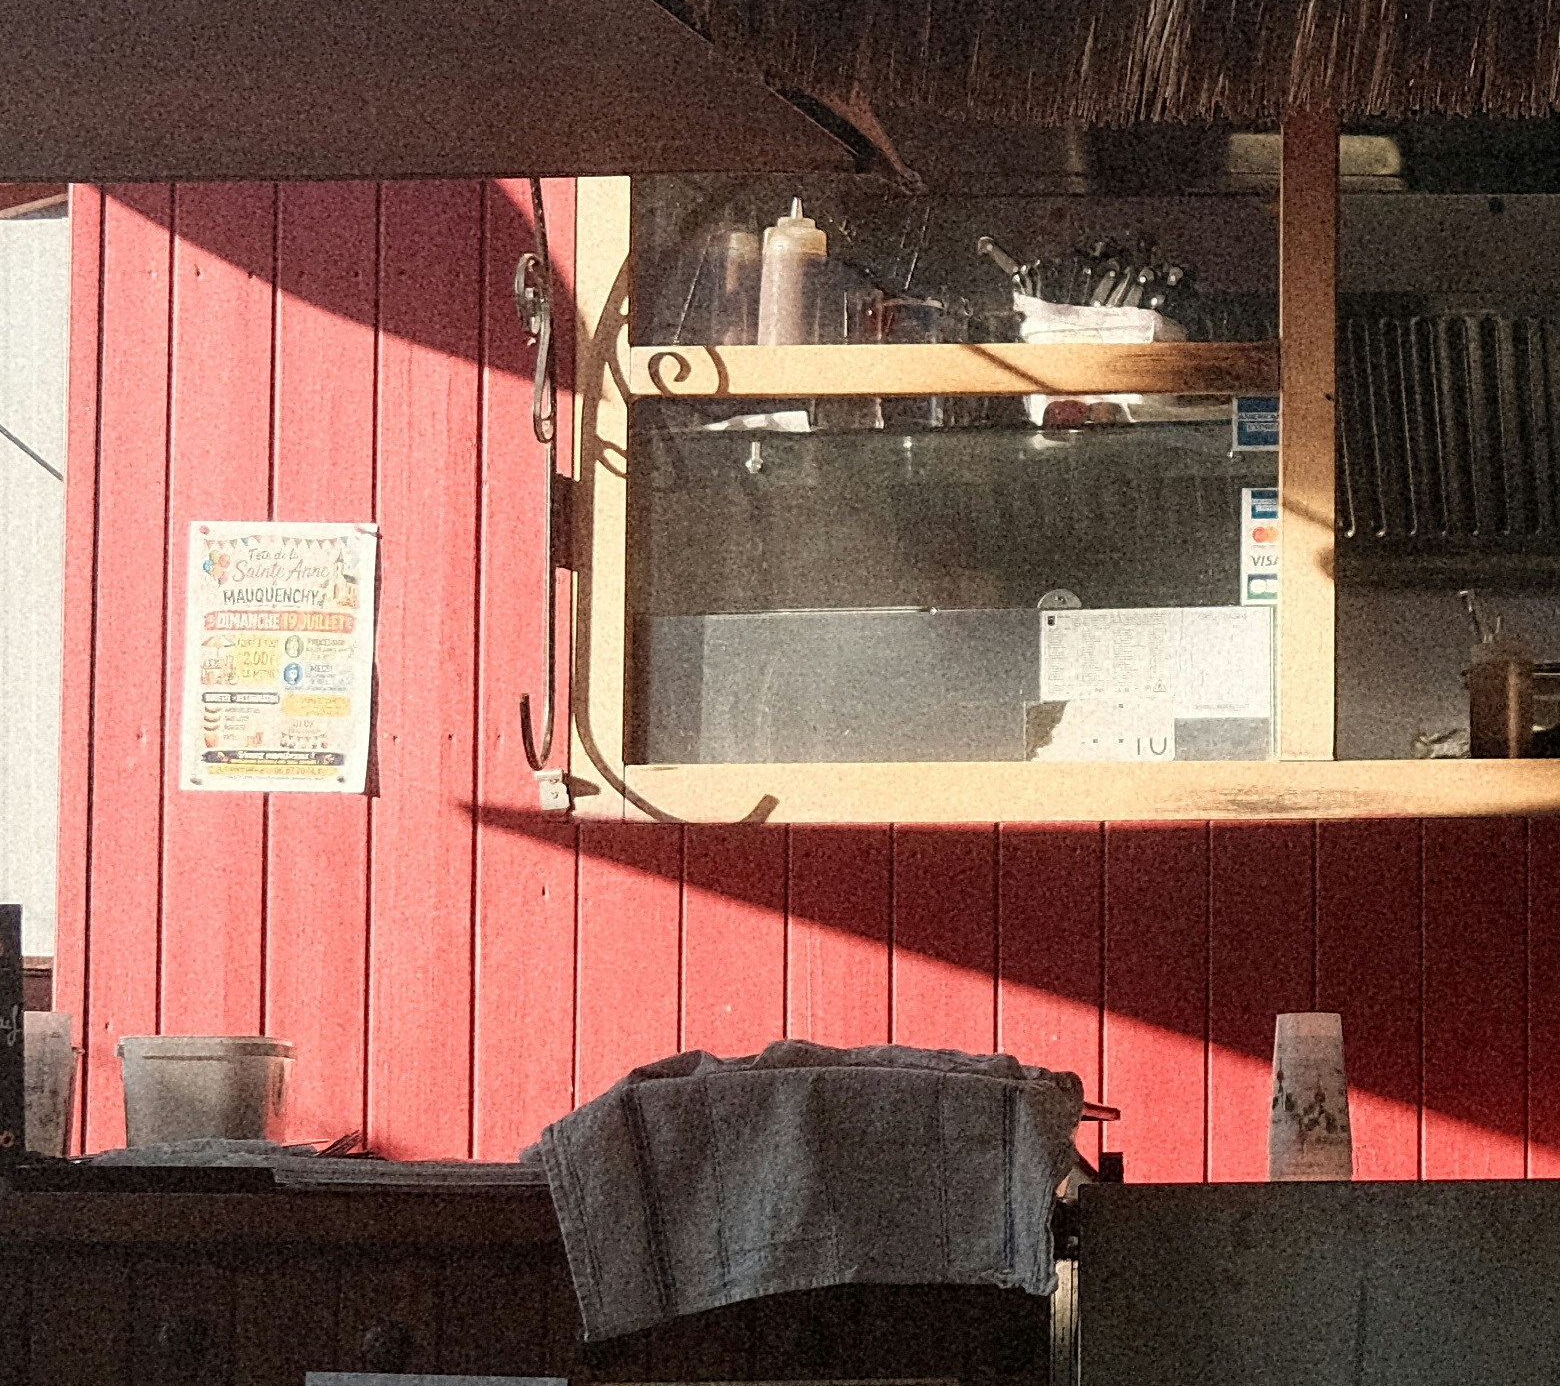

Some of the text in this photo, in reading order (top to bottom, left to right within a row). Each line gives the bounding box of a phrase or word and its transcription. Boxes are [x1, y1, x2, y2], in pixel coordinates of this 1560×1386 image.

[232, 558, 330, 582] Sainte Anne
[222, 586, 320, 605] MAUQUENCHY
[217, 614, 346, 631] DIMANCHE 19 JUILLET
